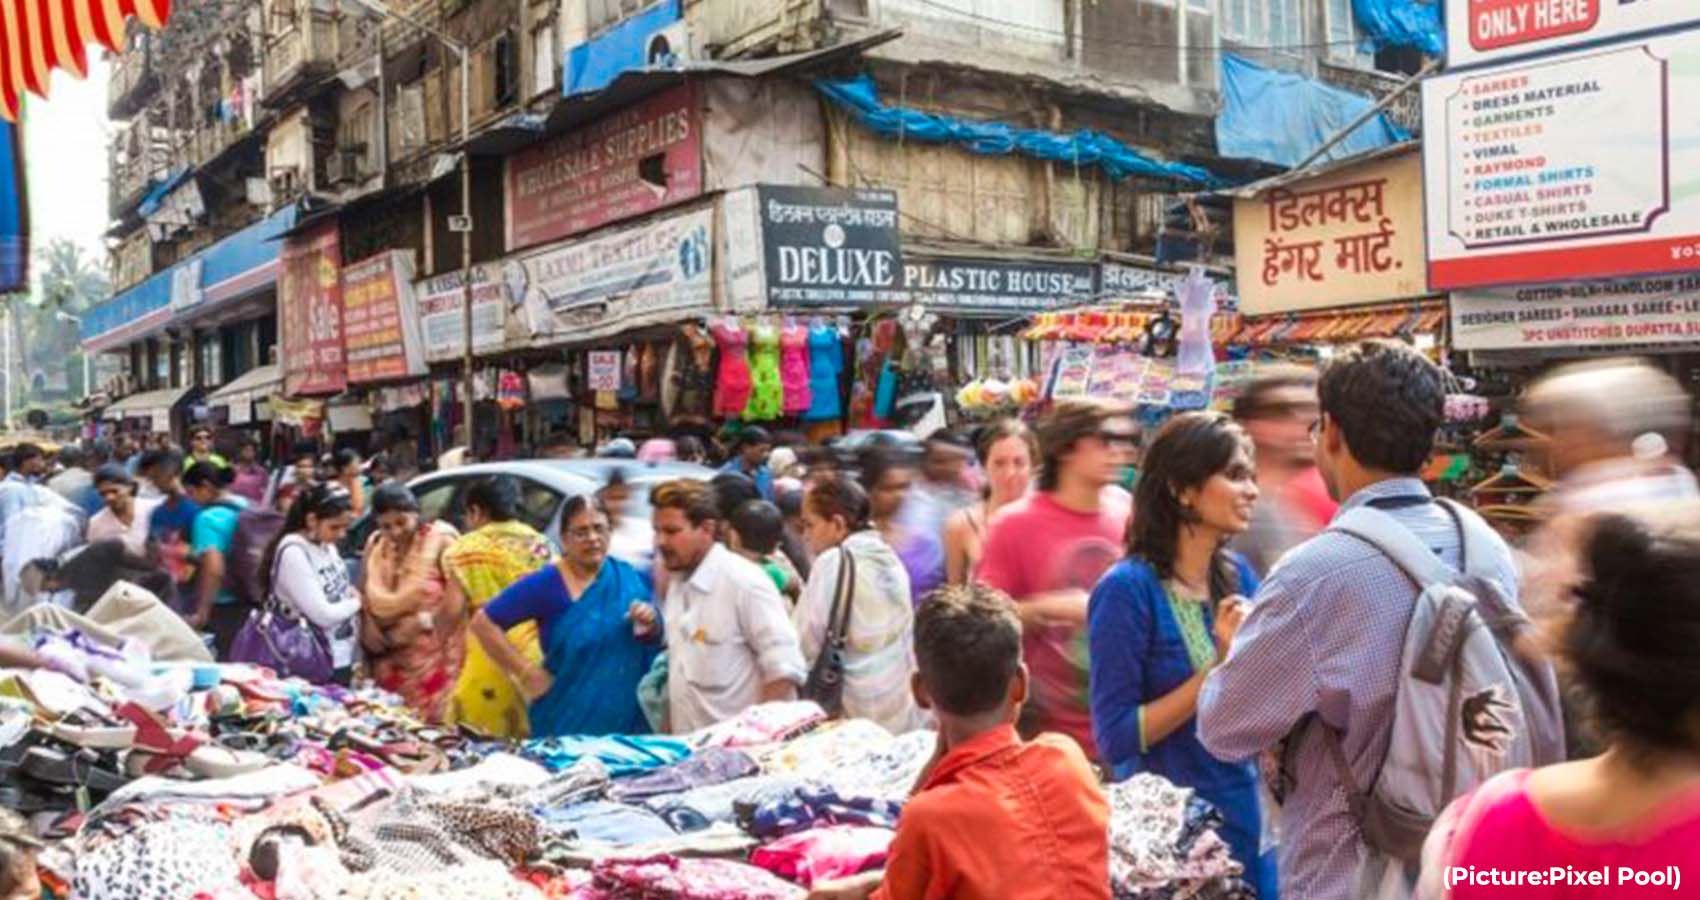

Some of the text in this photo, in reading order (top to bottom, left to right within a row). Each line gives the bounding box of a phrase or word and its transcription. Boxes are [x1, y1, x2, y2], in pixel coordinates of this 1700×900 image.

[1478, 0, 1588, 39] ONLY HERE
[1473, 81, 1600, 111] DRESS MATERIAL
[1474, 76, 1529, 95] SAREES
[1473, 105, 1555, 126] GARMENTS
[603, 107, 691, 166] SUPPLIES
[1474, 124, 1542, 142] TEXTILES
[1473, 144, 1518, 159] VIMAL
[1474, 156, 1546, 175] RAYMOND
[1474, 166, 1594, 190] FORMAL SHIRTS
[1266, 177, 1388, 232] डिलक्स
[1475, 184, 1593, 207] CASUAL SHIRTS
[1475, 200, 1588, 223] DUKE T-SHIRTS
[1475, 212, 1641, 240] RETAIL & WHOLESALE
[777, 245, 895, 286] DELUXE
[903, 265, 1001, 290] PLASTIC
[1007, 271, 1074, 294] HOUSE
[1461, 311, 1515, 325] DESIGNER
[1519, 308, 1562, 321] SAREES
[1572, 303, 1629, 319] SHARARA
[1632, 300, 1674, 316] SAREE
[1547, 325, 1623, 341] UNSTITCHED
[1626, 322, 1681, 337] DUPATTA
